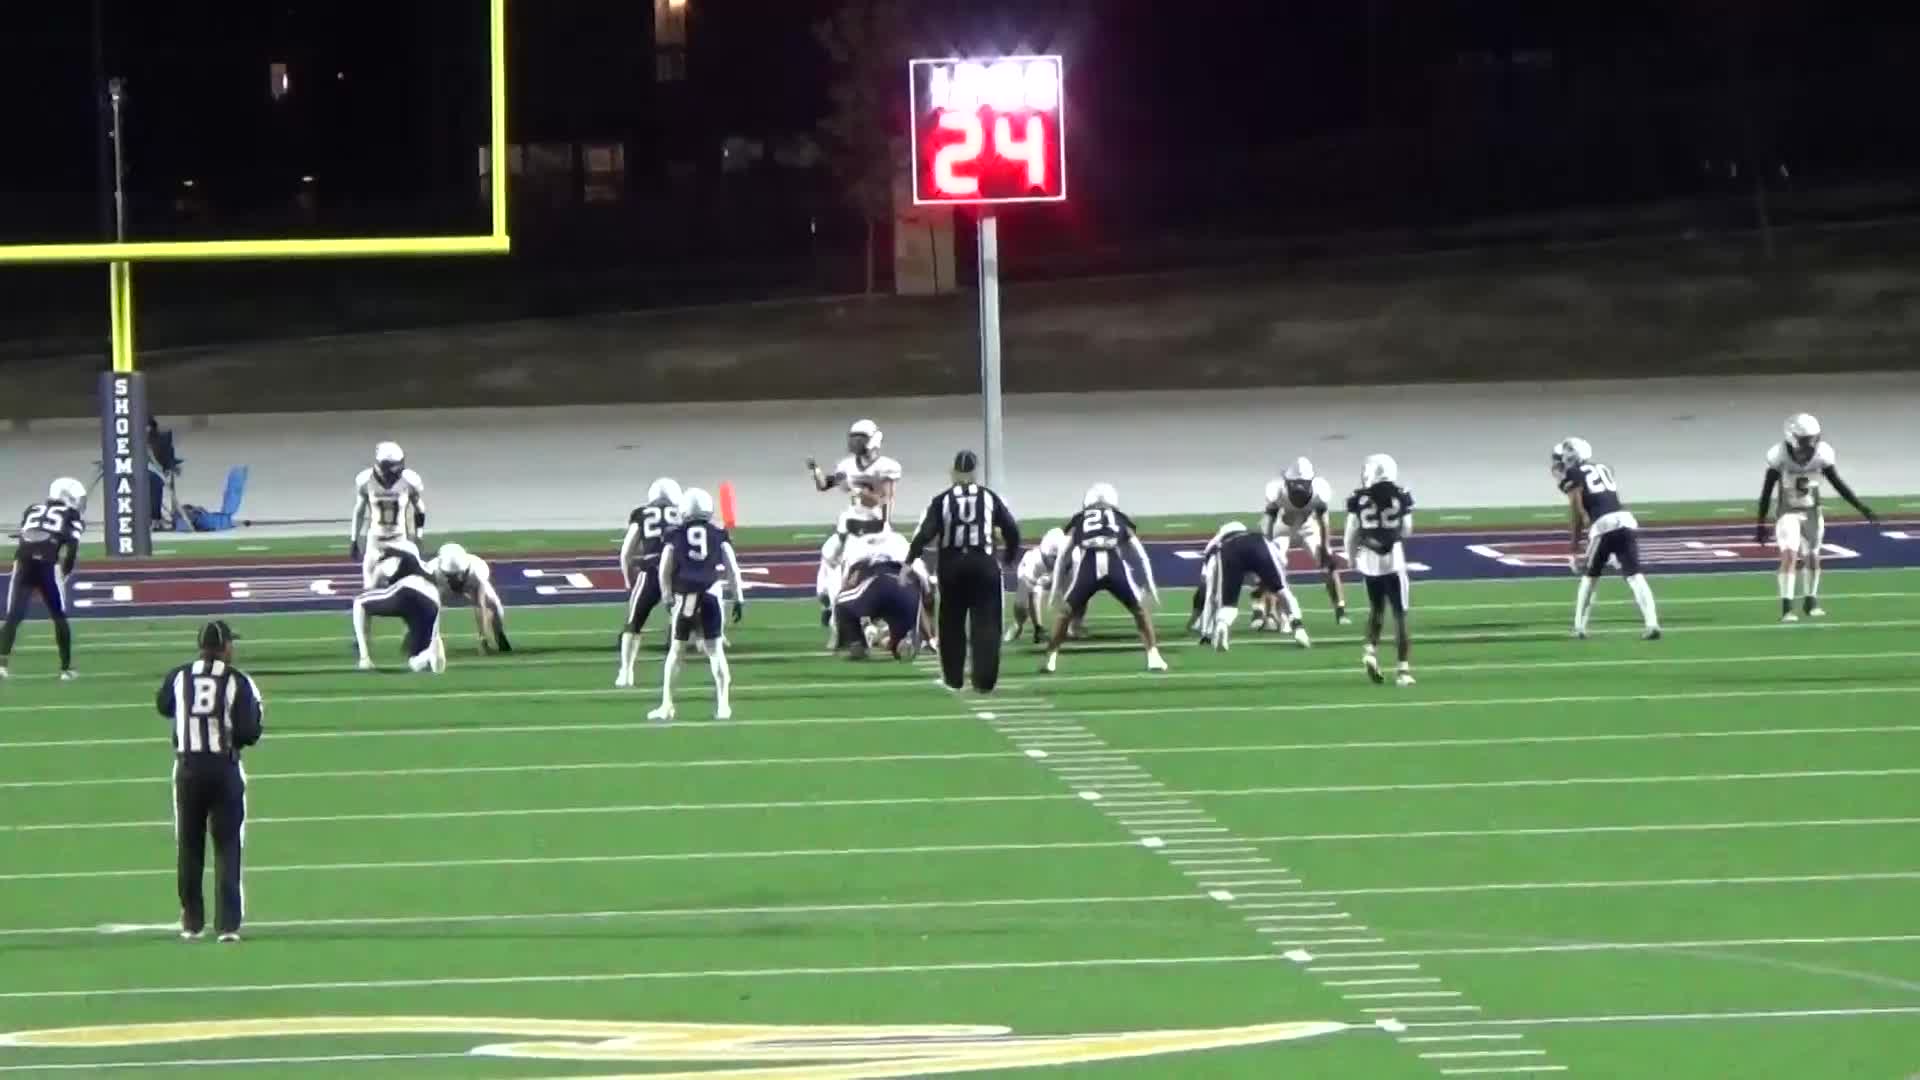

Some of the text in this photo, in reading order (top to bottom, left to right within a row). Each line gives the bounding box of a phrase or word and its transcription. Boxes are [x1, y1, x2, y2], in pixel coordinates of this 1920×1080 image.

[935, 112, 1045, 194] 24
[114, 379, 133, 553] SHOEMAKER
[1580, 463, 1617, 494] 20
[22, 504, 68, 532] 25
[955, 496, 977, 523] U
[1082, 509, 1121, 533] 21
[1358, 495, 1402, 530] 22
[686, 526, 708, 560] 9
[191, 677, 217, 714] B
